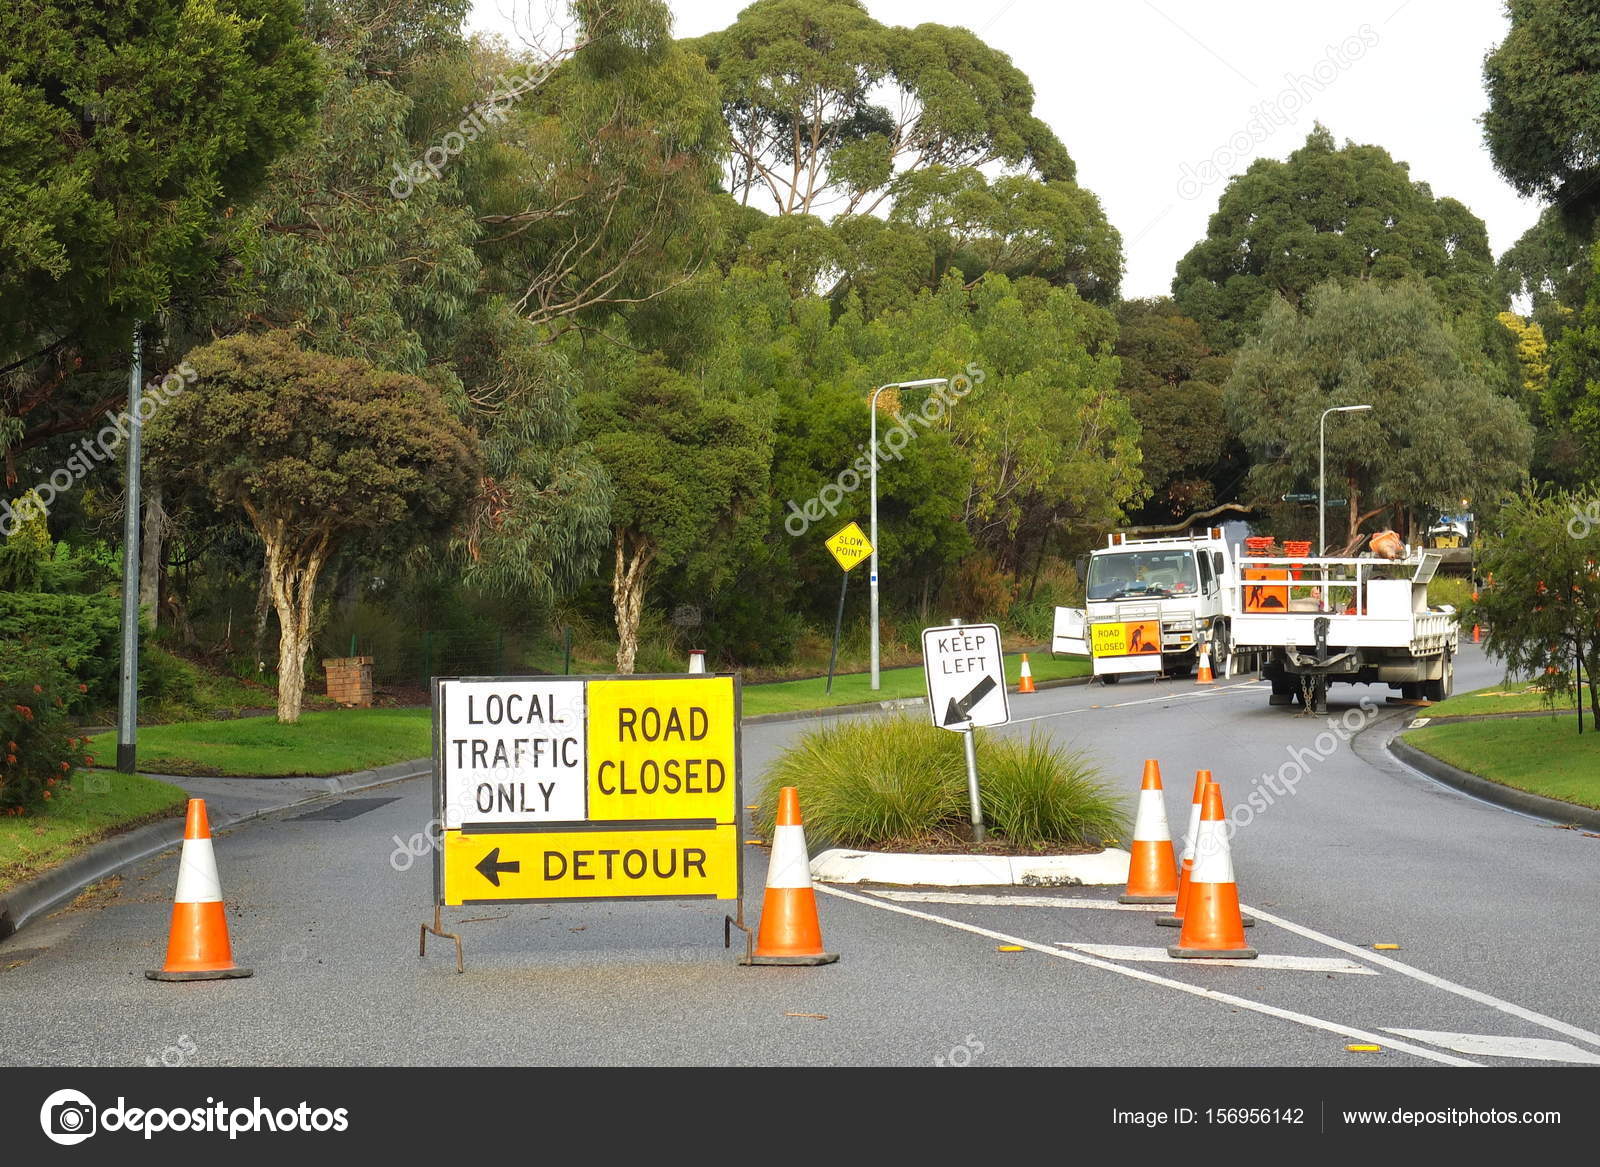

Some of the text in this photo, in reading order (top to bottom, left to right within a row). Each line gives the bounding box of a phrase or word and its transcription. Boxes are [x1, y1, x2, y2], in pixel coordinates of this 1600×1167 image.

[835, 546, 863, 559] POINT
[839, 535, 864, 547] SLOW
[938, 635, 986, 653] KEEP
[1098, 629, 1120, 638] ROAD
[1094, 641, 1125, 652] CLOSED
[942, 657, 986, 675] LEFT
[468, 694, 564, 725] LOCAL
[619, 707, 709, 742] ROAD
[453, 737, 578, 769] TRAFFIC
[598, 759, 726, 795] CLOSED
[476, 782, 556, 814] ONLY
[543, 848, 707, 881] DETOUR
